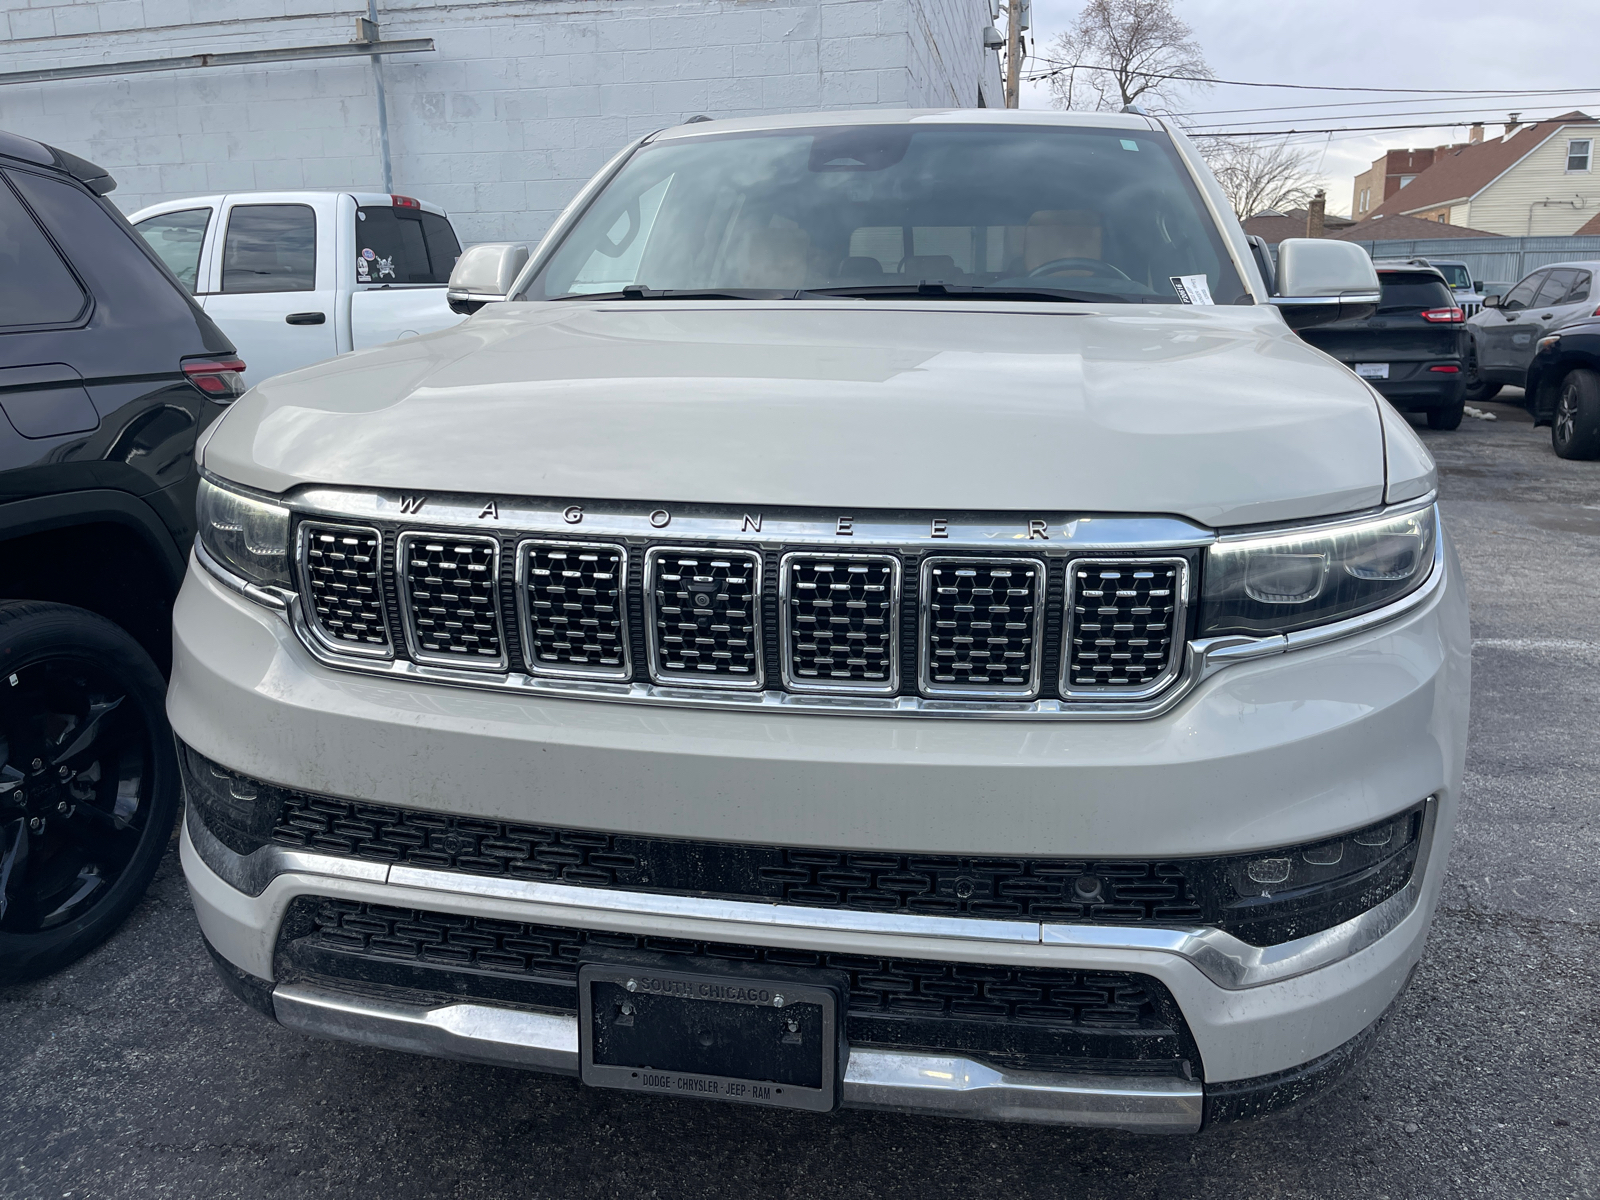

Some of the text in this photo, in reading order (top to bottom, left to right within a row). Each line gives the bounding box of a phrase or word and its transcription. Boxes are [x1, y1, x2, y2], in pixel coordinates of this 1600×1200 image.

[398, 494, 1050, 541] WAGONEER
[641, 977, 771, 1003] SOUTH CHICAGO
[643, 1074, 671, 1089] DODGE
[677, 1077, 719, 1094] CHRYSLER
[726, 1082, 746, 1097] JEEP
[752, 1086, 771, 1100] RAM
